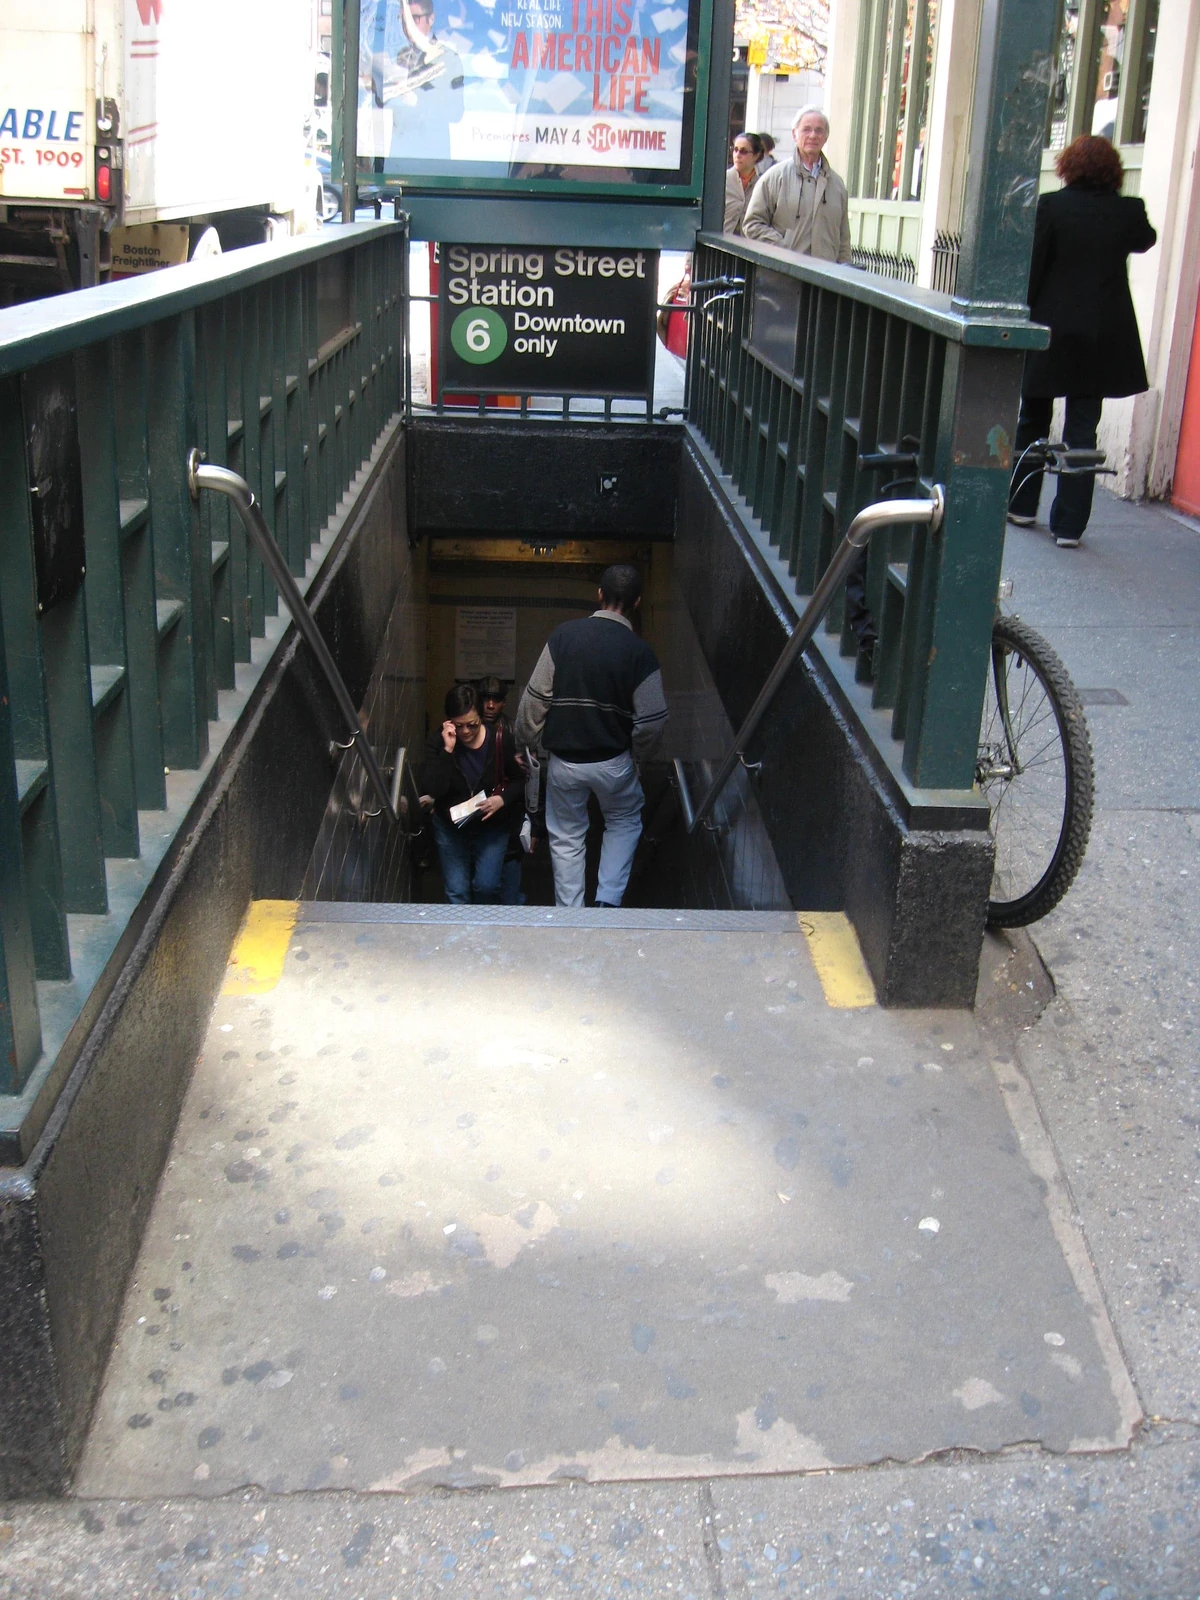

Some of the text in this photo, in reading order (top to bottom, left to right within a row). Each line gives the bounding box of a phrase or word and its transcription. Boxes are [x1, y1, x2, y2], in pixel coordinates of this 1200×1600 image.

[501, 14, 564, 29] NEW SEASON.
[571, 0, 632, 35] THIS
[511, 31, 661, 75] AMERICAN
[593, 73, 650, 113] LIFE
[0, 108, 84, 142] ABLE
[472, 123, 667, 153] Premieres MAY 4 SHOWTIME
[36, 149, 83, 168] 1909
[112, 256, 170, 268] Freightliner
[123, 244, 161, 256] Boston
[448, 246, 646, 281] Spring Street
[448, 277, 554, 307] Station
[466, 312, 625, 352] 6 Downtown
[514, 335, 558, 357] only
